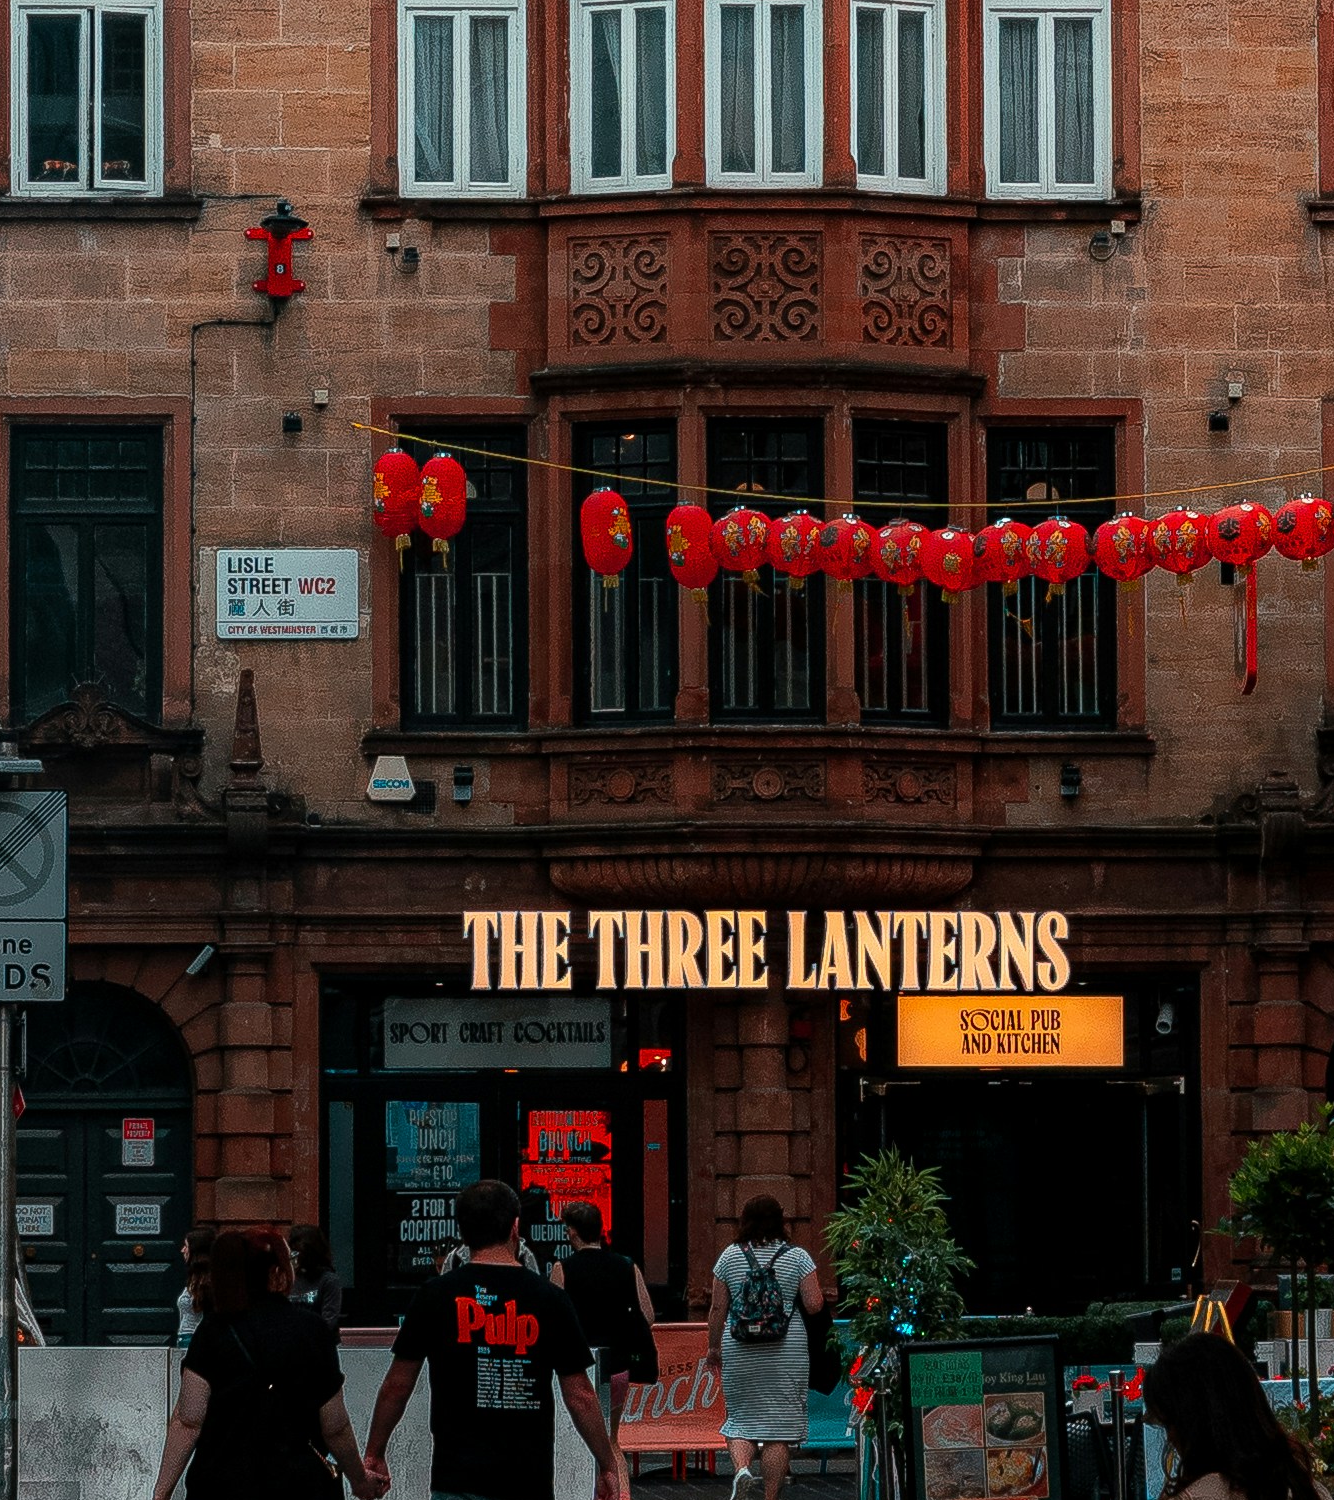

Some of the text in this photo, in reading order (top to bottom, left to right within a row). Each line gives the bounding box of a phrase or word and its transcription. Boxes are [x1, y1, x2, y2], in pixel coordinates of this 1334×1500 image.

[227, 556, 274, 574] LISLE
[227, 577, 336, 595] STREET WC2
[227, 625, 317, 635] CITY OF WESTMINSTER
[372, 779, 410, 789] SECOM
[463, 910, 1071, 991] THE THREE LANTERNS
[959, 1009, 1061, 1032] SOCIAL PUB
[389, 1021, 606, 1045] SPORT CRAFT COCKTAILS
[961, 1033, 1061, 1054] AND KITCHEN
[538, 1130, 593, 1152] BRUNCH
[433, 1165, 454, 1181] £10
[411, 1199, 420, 1217] 2
[422, 1199, 446, 1217] FOR
[399, 1219, 462, 1241] COCKTAIL
[454, 1296, 540, 1355] Pulp
[983, 1371, 1046, 1386] oy King Lau
